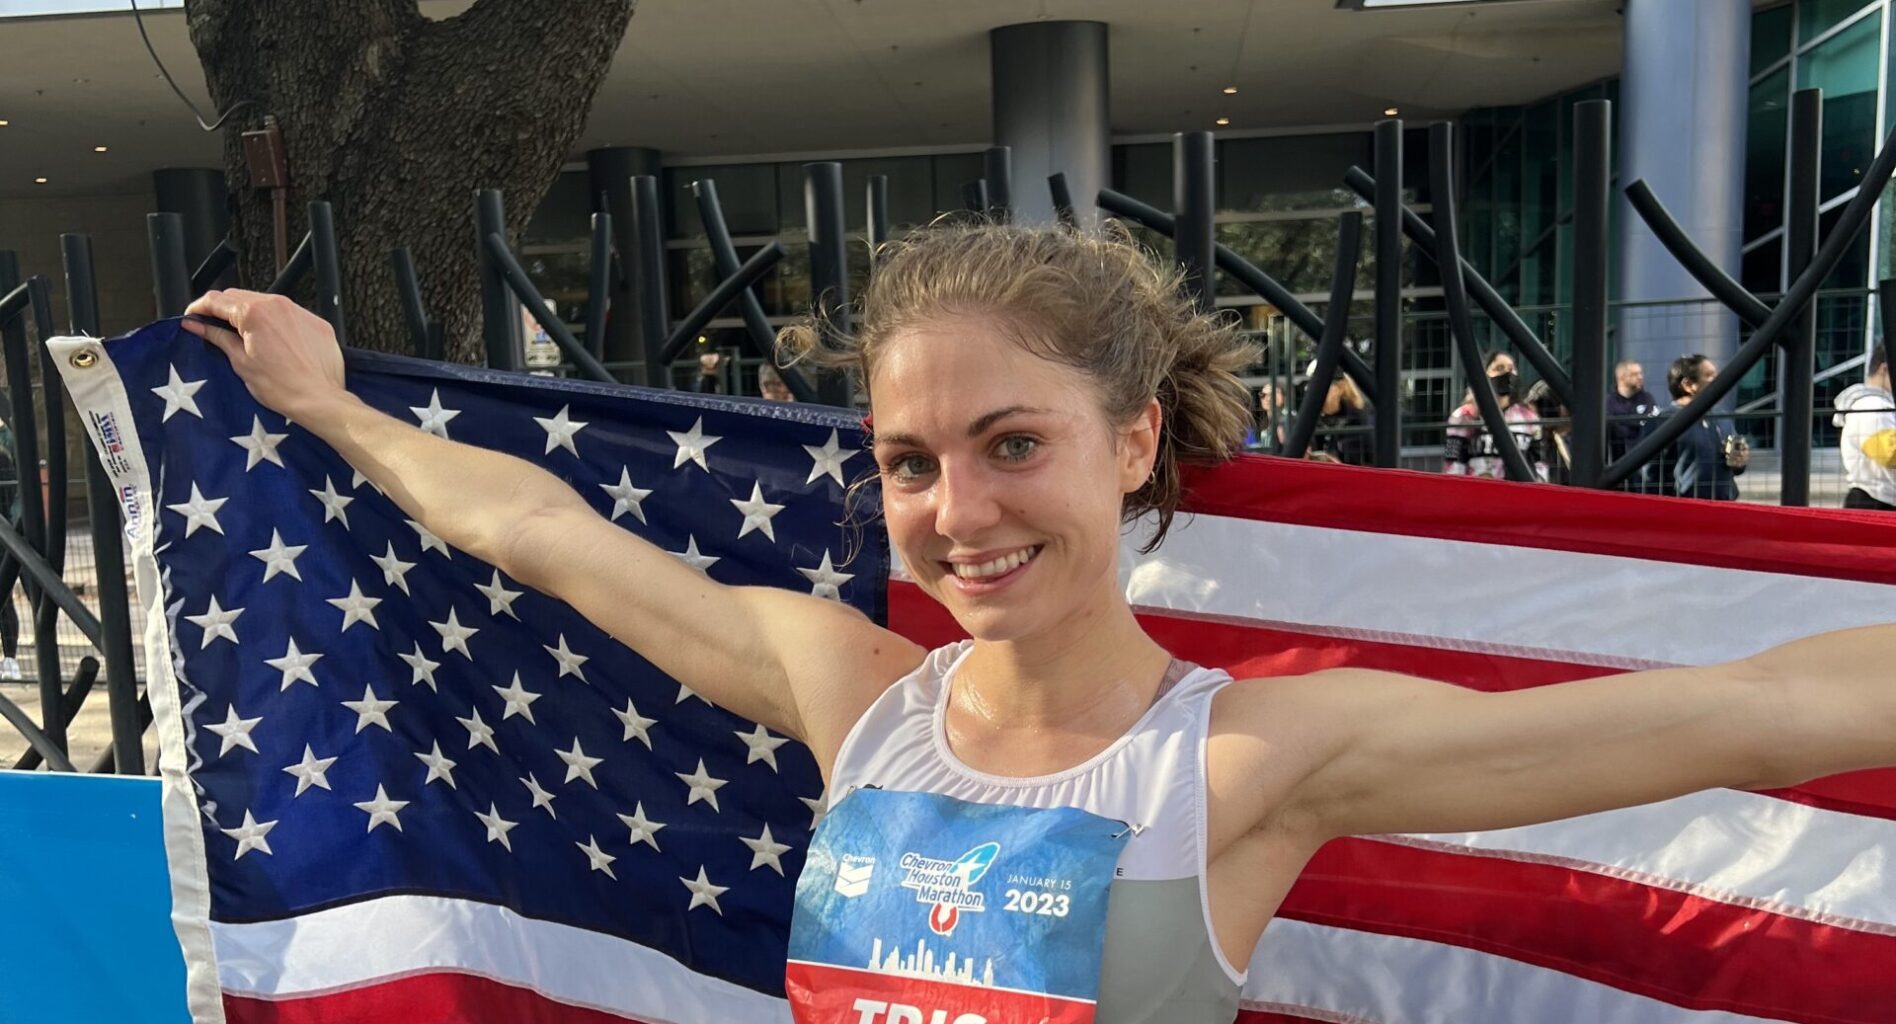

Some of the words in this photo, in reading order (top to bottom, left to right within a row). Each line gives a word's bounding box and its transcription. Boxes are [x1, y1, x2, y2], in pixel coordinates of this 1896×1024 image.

[842, 853, 876, 865] Chevron
[901, 853, 951, 872] Chevron
[908, 868, 961, 888] Houston
[1007, 874, 1057, 890] JANUARY
[1060, 879, 1072, 891] 15
[918, 886, 982, 907] Marathon
[1002, 888, 1071, 918] 2023
